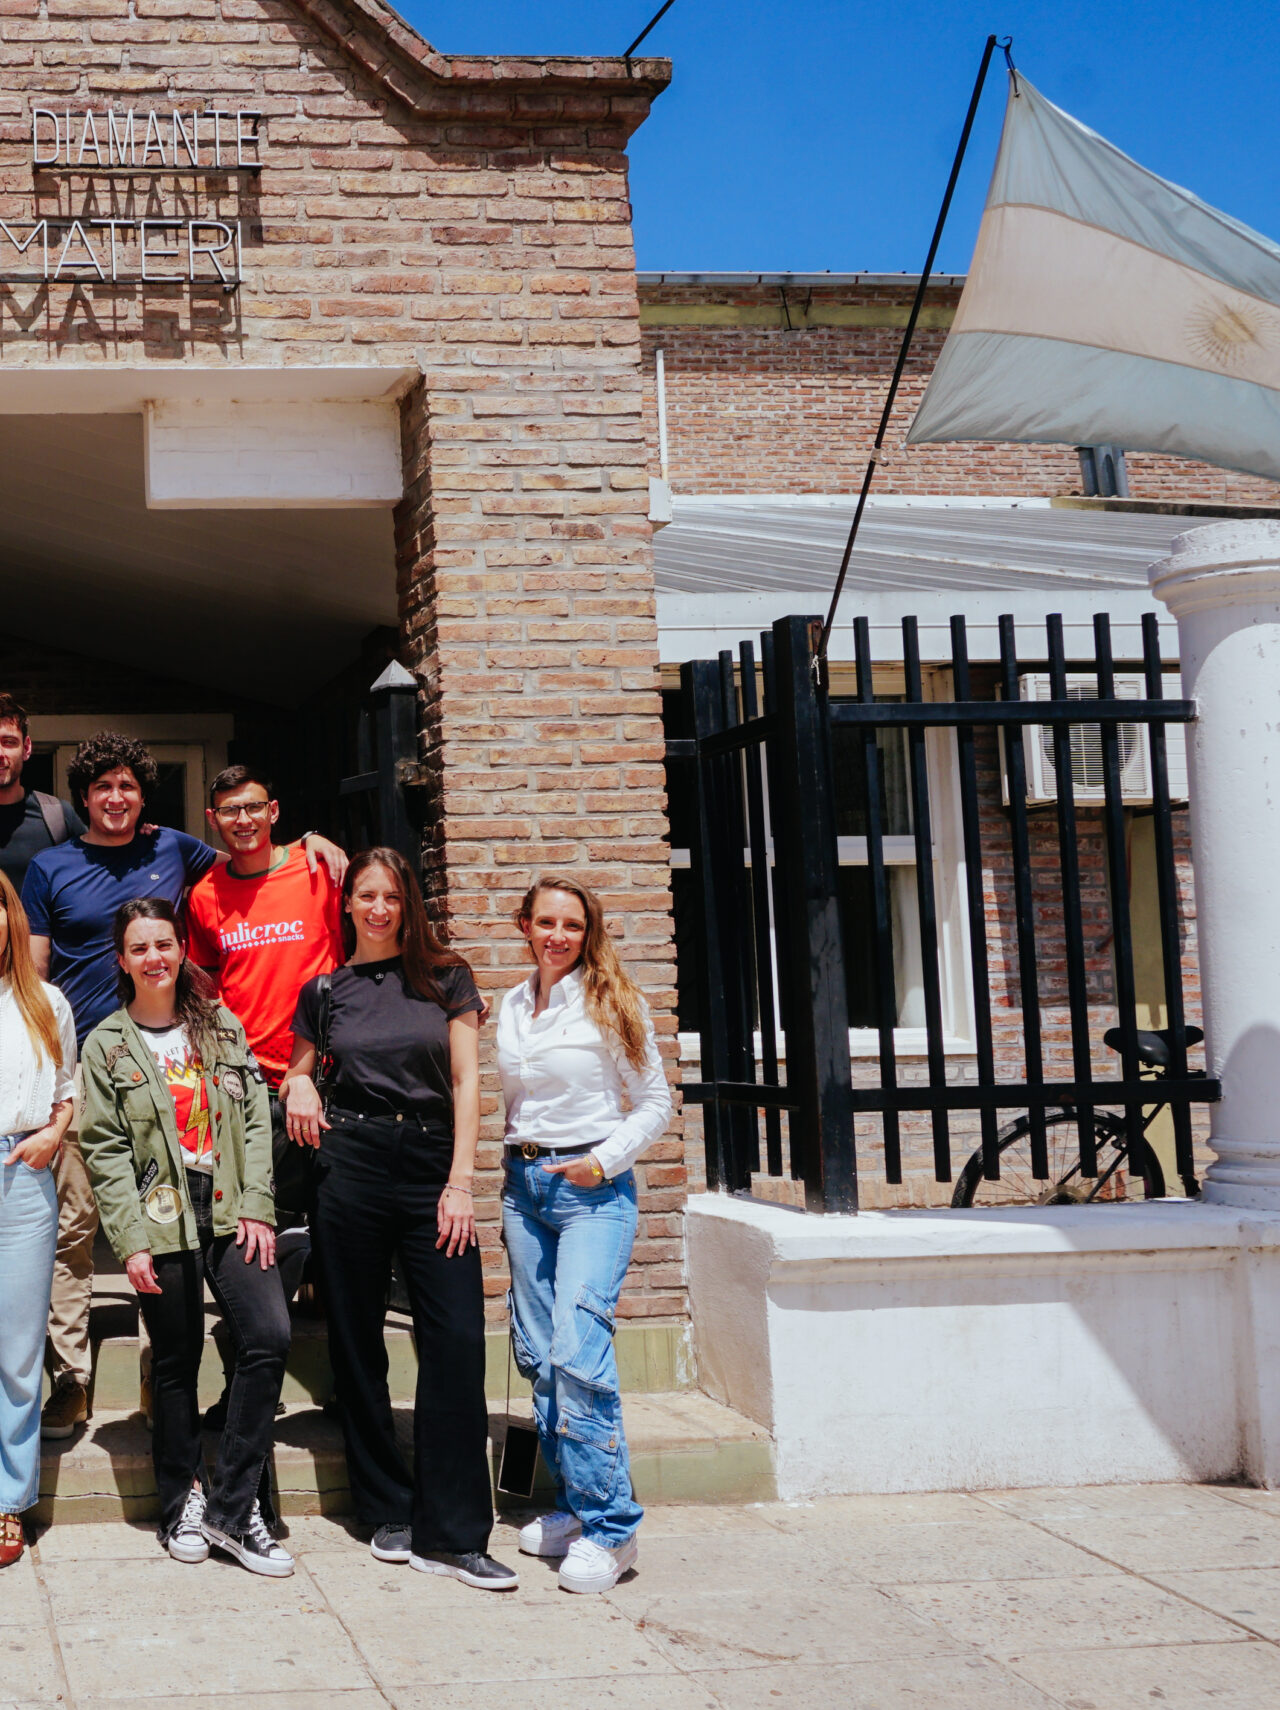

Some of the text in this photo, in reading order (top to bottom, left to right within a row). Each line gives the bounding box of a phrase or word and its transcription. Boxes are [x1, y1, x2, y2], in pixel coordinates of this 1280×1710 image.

[33, 109, 263, 168] DIAMANTE
[219, 919, 303, 954] julicroc
[277, 933, 305, 943] snacks
